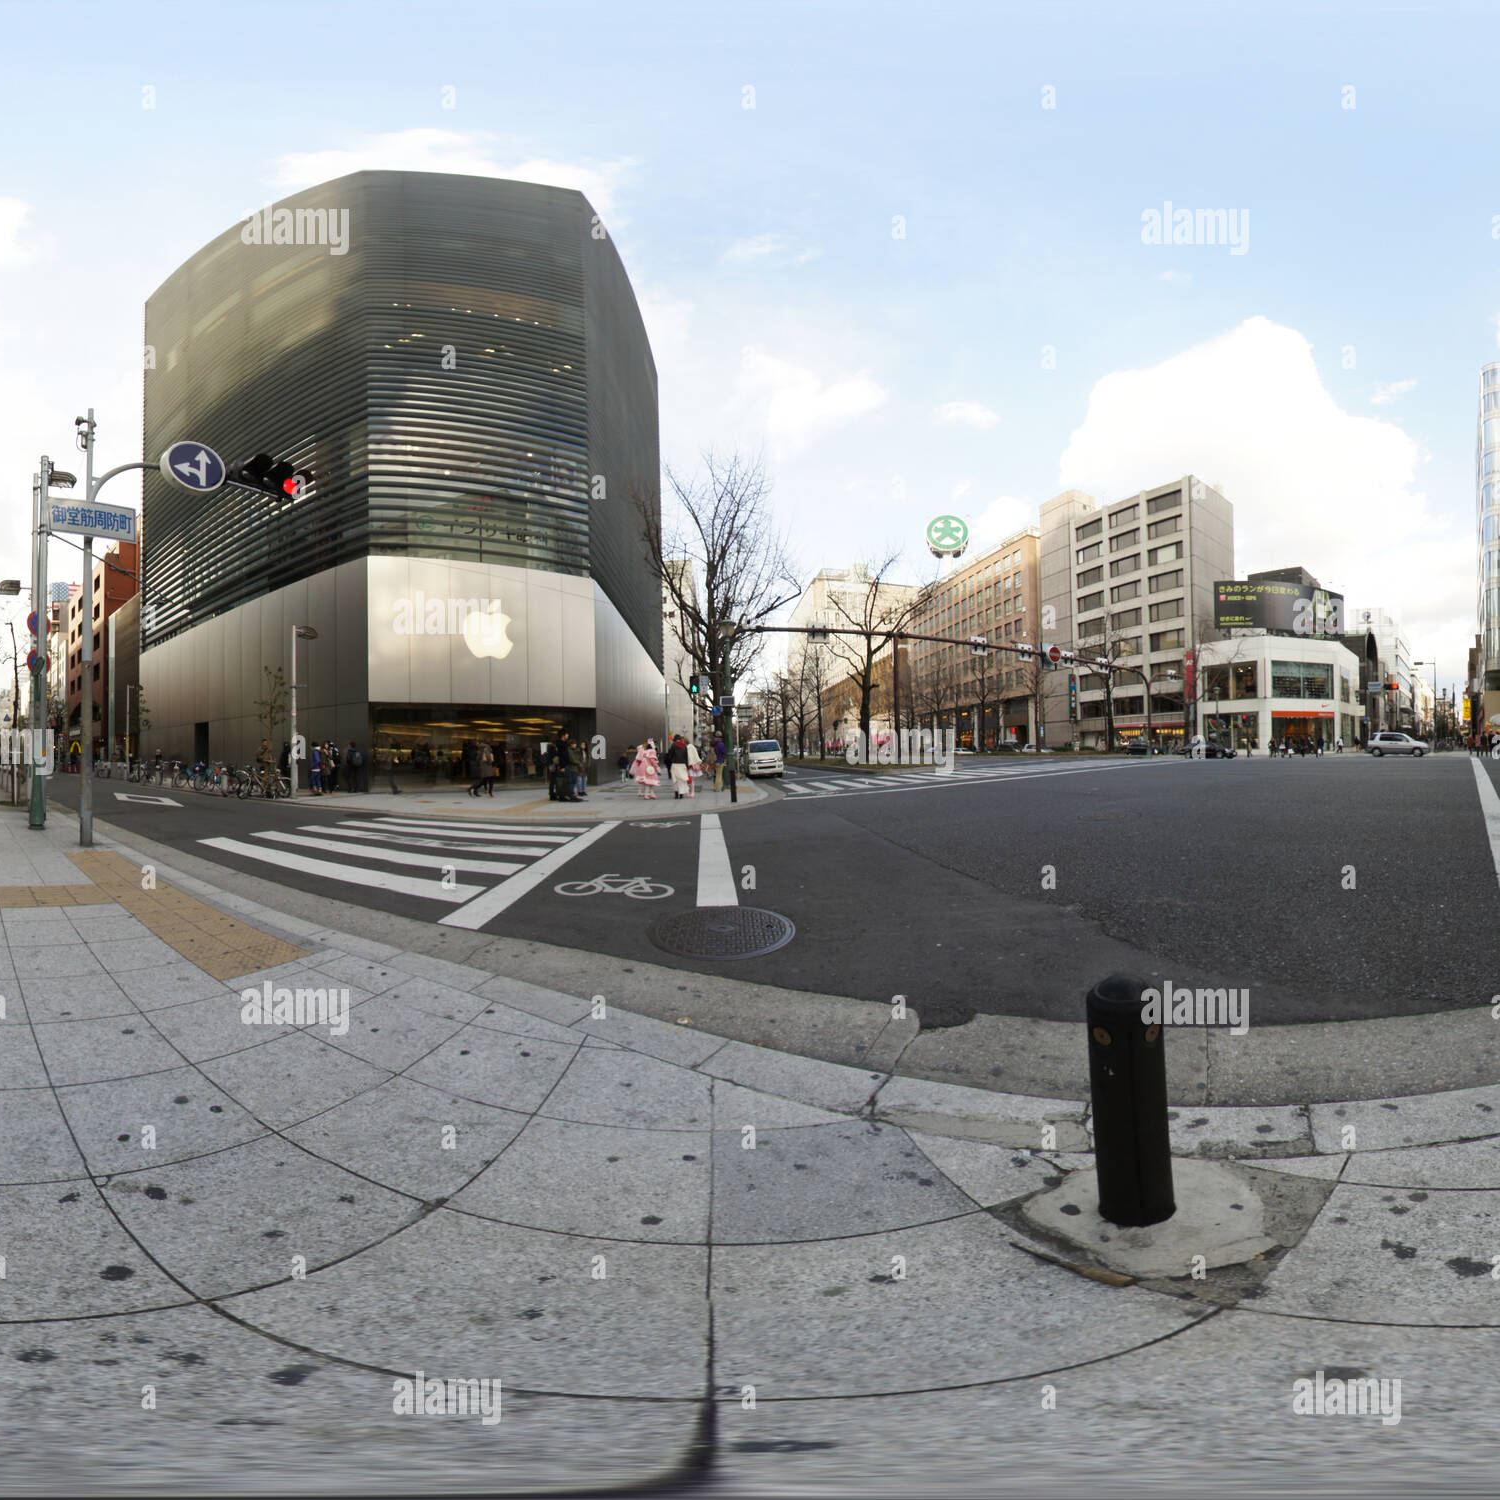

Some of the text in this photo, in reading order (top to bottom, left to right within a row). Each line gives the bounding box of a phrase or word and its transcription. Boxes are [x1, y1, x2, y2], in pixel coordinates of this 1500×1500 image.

[52, 505, 132, 534] 御堂筋周防町
